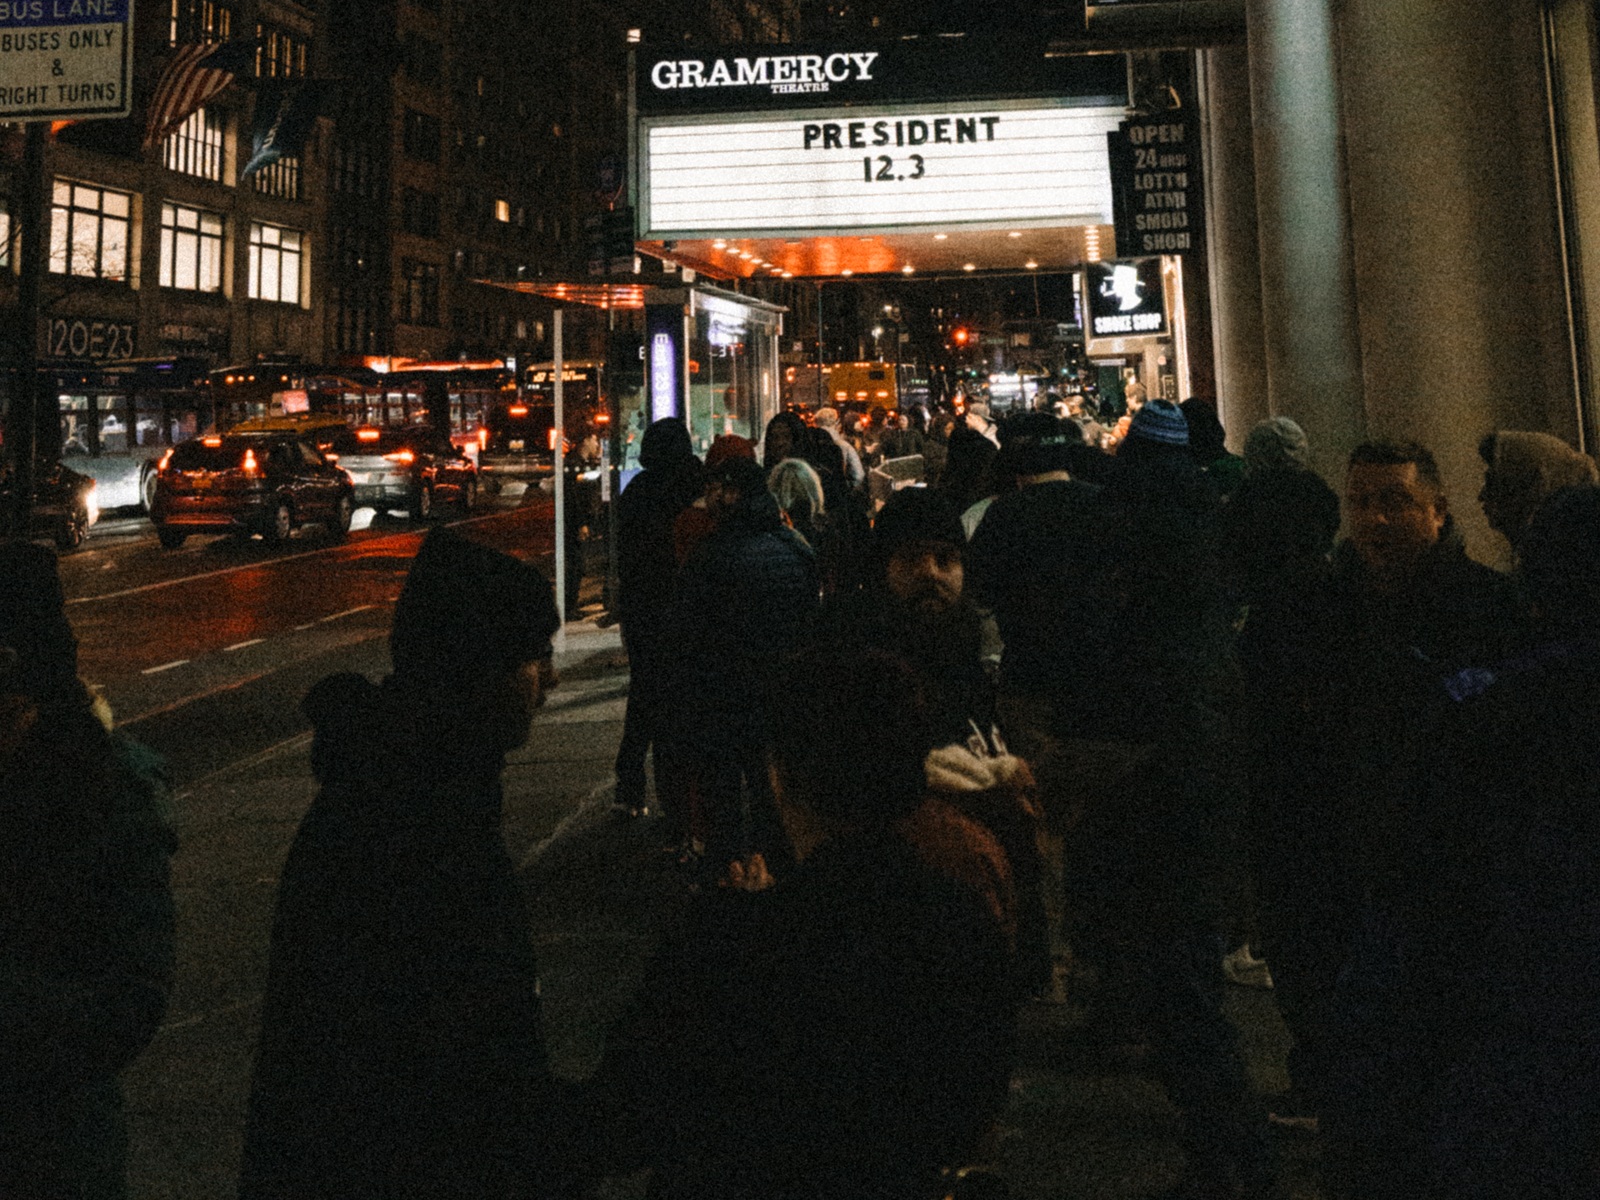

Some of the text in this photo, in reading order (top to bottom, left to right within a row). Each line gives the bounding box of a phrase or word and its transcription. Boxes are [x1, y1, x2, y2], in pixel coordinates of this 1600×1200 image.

[0, 1, 43, 20] BUS
[2, 29, 114, 52] BUSES ONLY
[52, 58, 64, 76] &
[651, 52, 878, 89] GRAMERCY
[0, 83, 116, 105] RIGHT TURNS
[771, 82, 830, 94] THEATRE
[803, 116, 1000, 150] PRESIDENT
[1129, 124, 1184, 144] OPEN
[863, 154, 926, 183] 12.3
[1134, 148, 1157, 169] 24
[1095, 313, 1161, 333] SMOKE SHOP
